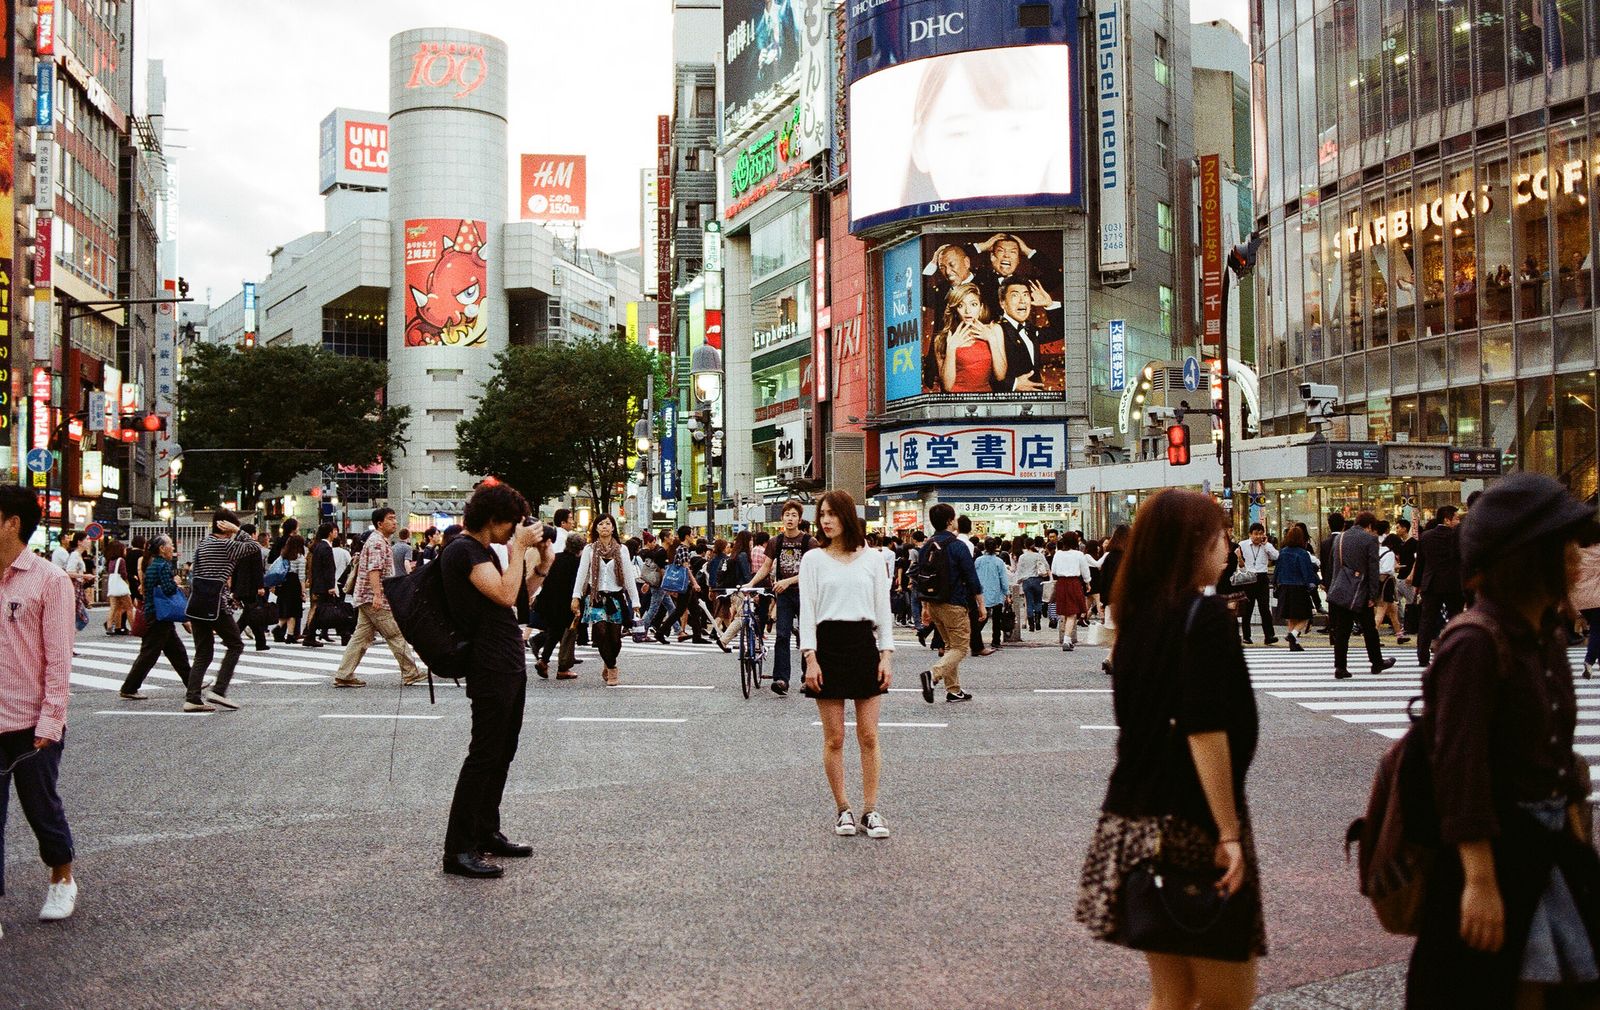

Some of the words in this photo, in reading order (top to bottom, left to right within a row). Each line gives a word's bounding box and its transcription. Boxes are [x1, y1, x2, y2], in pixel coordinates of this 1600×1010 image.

[852, 1, 869, 18] DHC
[910, 12, 965, 43] DHC
[1099, 2, 1118, 100] Taisei
[405, 51, 488, 99] 109
[349, 126, 387, 149] UNI
[1102, 110, 1117, 190] neon
[349, 147, 389, 169] QLO
[533, 160, 575, 189] H&M
[549, 203, 580, 214] 150m
[929, 202, 950, 213] DHC
[1204, 160, 1217, 262] クスリのことなら
[1333, 185, 1492, 259] STARBUCKS
[1104, 223, 1122, 232] (03)
[1104, 232, 1123, 241] 3719
[1104, 240, 1123, 250] 2468
[1205, 271, 1221, 335] 三千里
[887, 318, 919, 349] DMM
[892, 345, 916, 375] FX
[884, 433, 1054, 474] 大盛堂書店
[1336, 459, 1363, 470] 渋谷駅
[965, 503, 1021, 512] 3月のライオン
